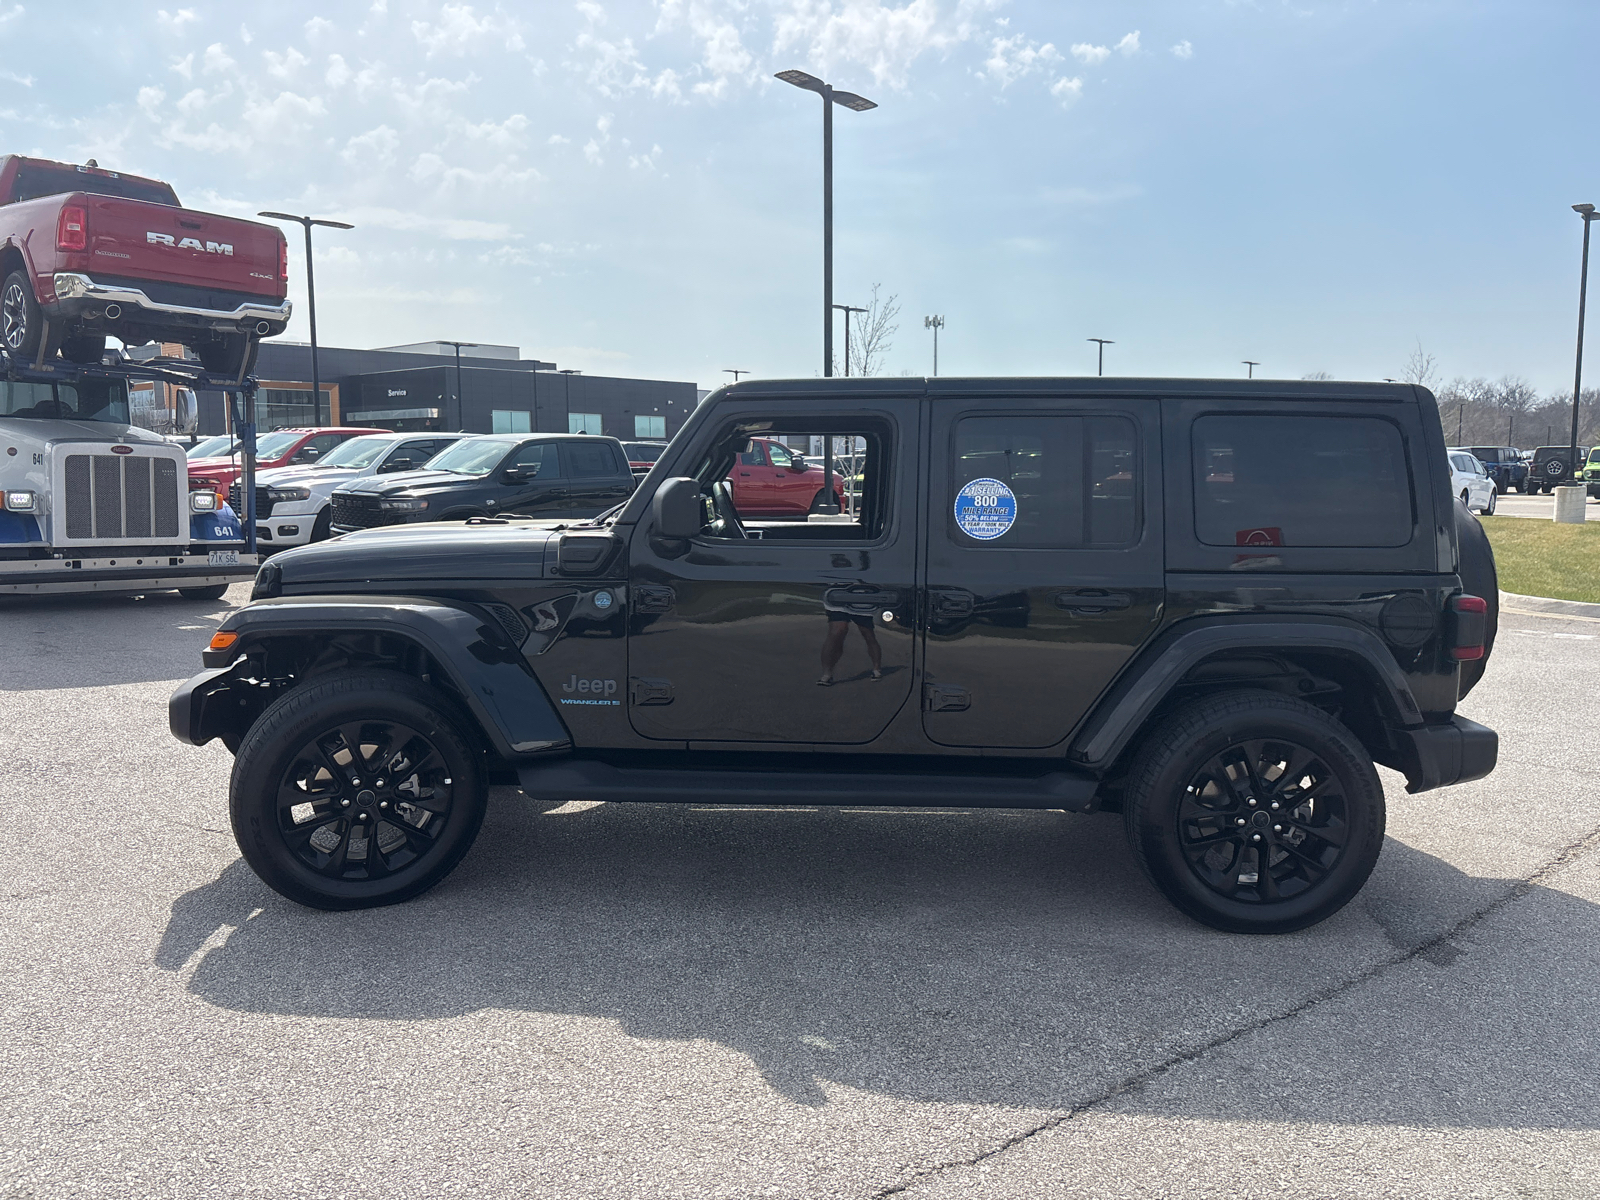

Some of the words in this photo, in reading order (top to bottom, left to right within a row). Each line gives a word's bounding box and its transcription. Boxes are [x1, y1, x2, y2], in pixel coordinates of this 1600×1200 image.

[146, 231, 233, 256] RAM
[388, 389, 407, 397] Service
[33, 453, 43, 465] 641
[977, 486, 1009, 496] SELLING
[974, 495, 998, 507] 800
[962, 507, 981, 515] MILE
[983, 507, 1009, 515] RANGE
[214, 526, 234, 536] 641
[562, 674, 617, 697] Jeep
